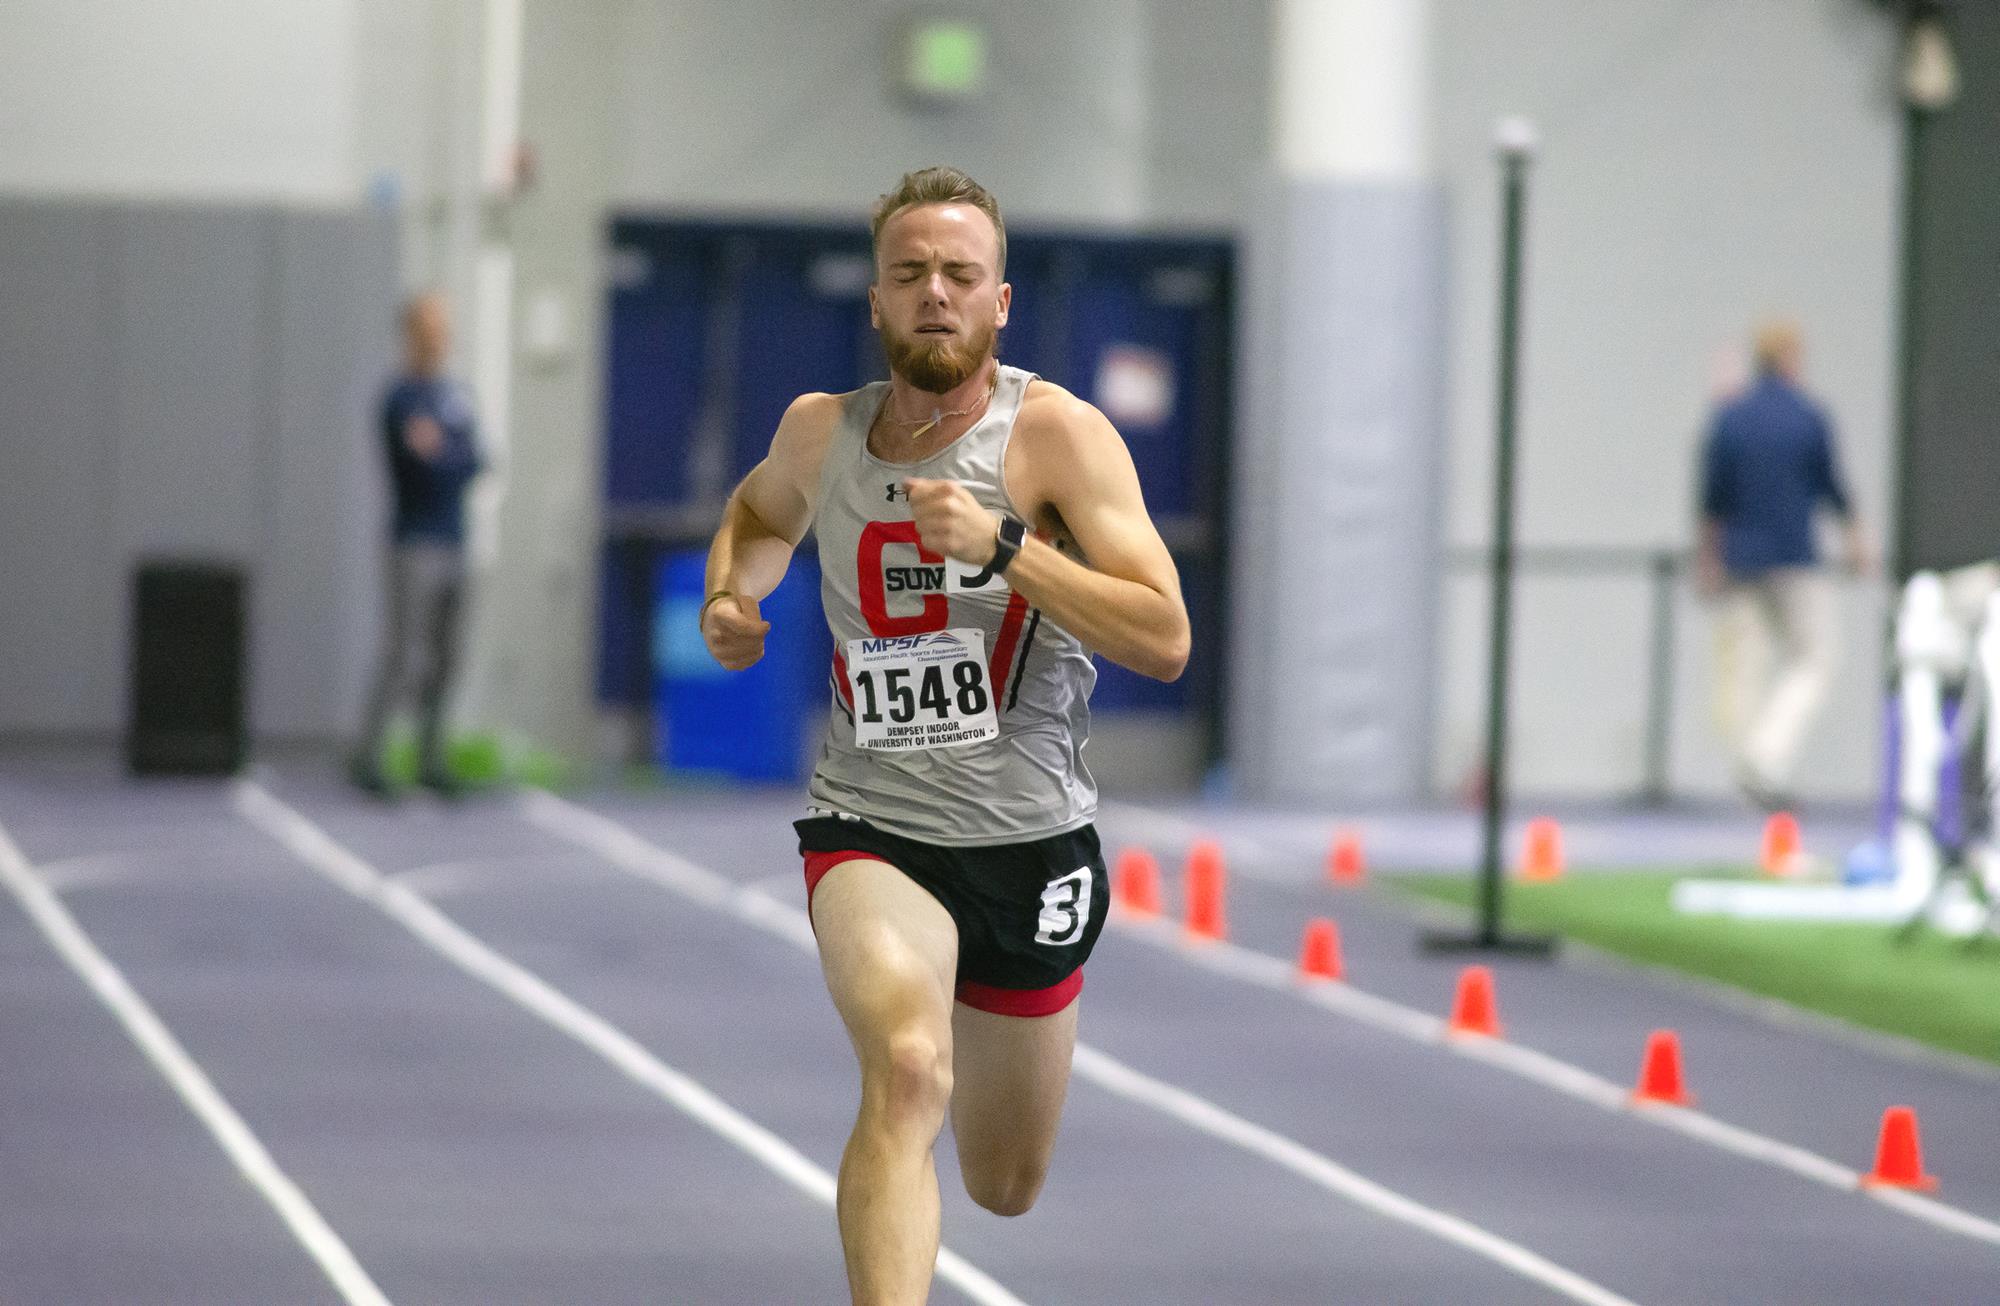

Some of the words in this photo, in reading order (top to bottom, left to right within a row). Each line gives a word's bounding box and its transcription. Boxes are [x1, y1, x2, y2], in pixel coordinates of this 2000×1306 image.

[885, 567, 945, 592] SUN
[862, 633, 931, 654] MPSF
[856, 660, 988, 723] 1548
[868, 737, 913, 748] UNIVERSITY
[915, 736, 925, 746] OF
[927, 727, 986, 745] WASHINGTON
[887, 725, 924, 737] DEMPSEY
[926, 721, 960, 733] INDOOR
[1048, 877, 1082, 942] 3
